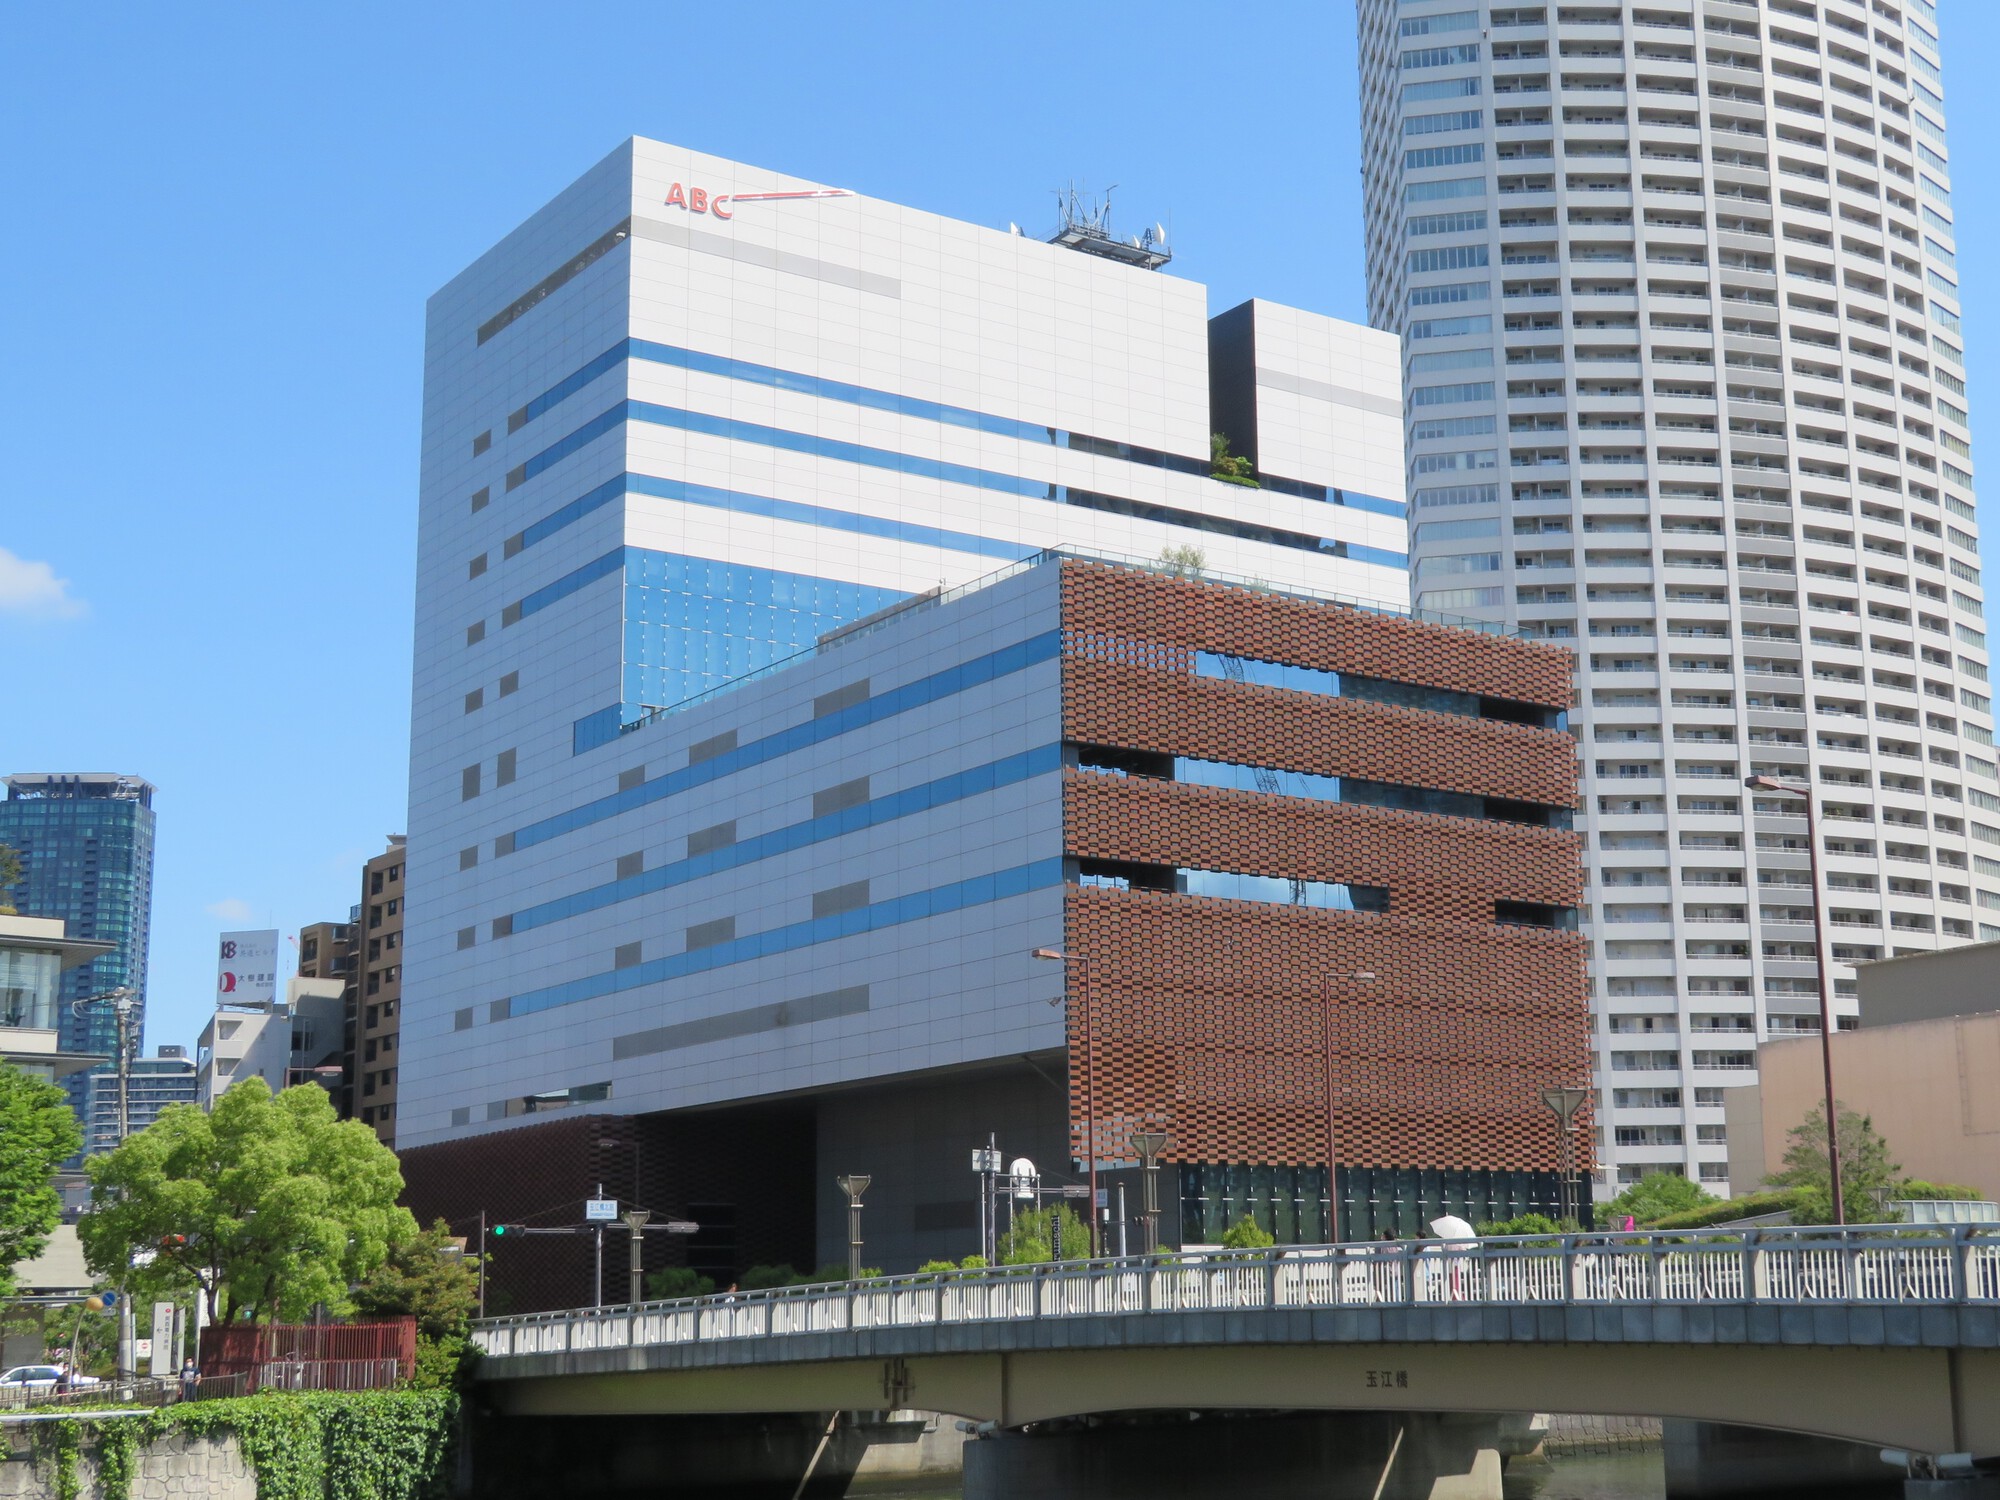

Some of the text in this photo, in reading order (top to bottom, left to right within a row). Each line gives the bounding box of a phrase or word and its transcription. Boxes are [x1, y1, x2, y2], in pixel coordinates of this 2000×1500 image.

[664, 182, 733, 219] ABC
[1366, 1371, 1408, 1388] 玉江橋
